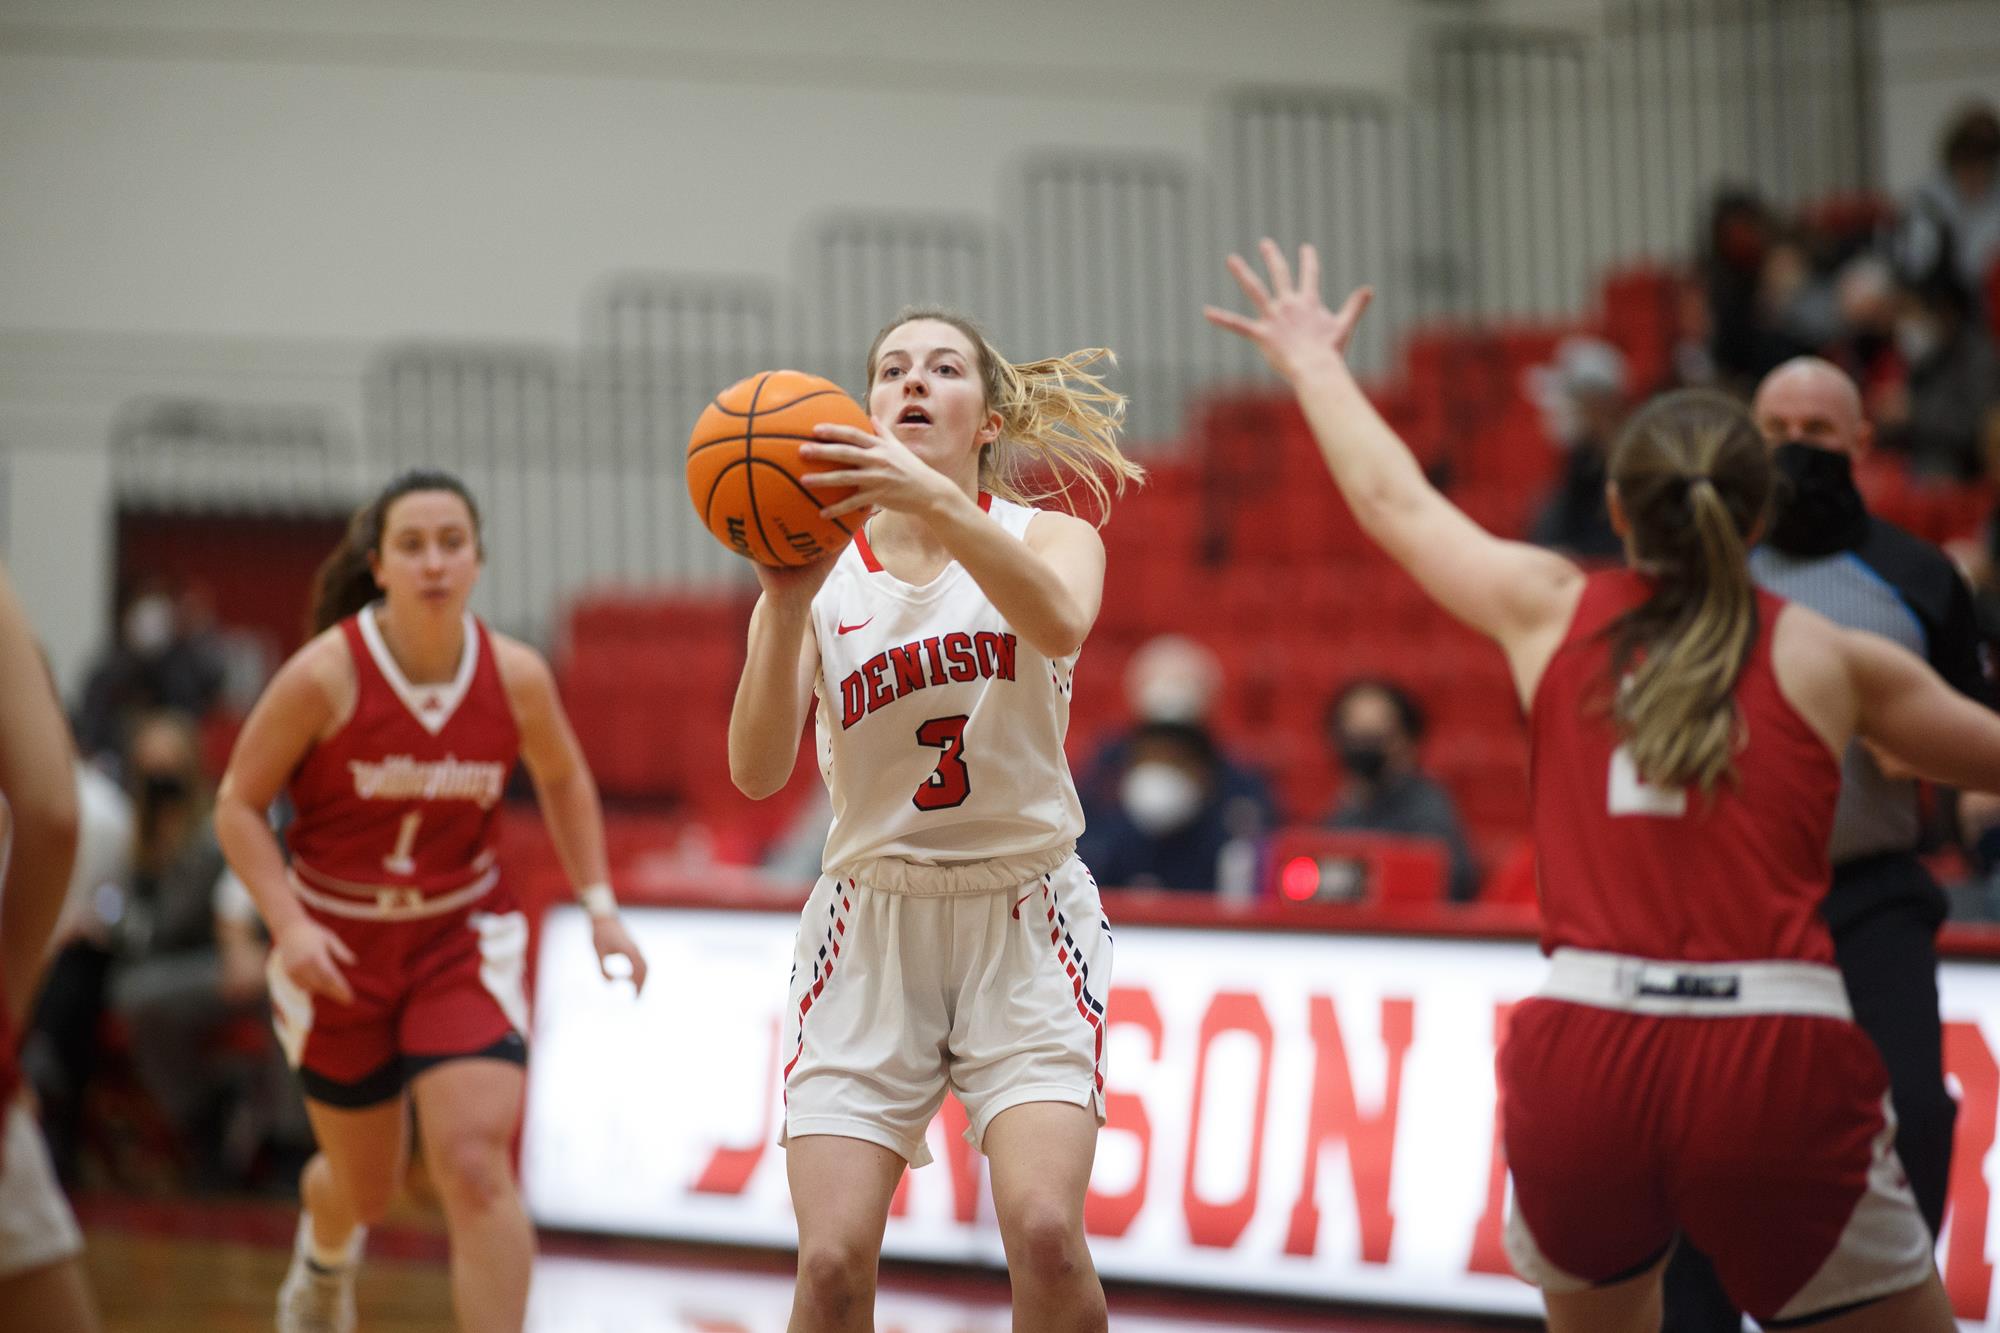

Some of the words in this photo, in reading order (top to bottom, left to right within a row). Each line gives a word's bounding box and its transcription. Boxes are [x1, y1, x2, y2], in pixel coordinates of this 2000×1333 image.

[840, 631, 1017, 731] DENISON
[912, 714, 972, 812] 3
[382, 810, 416, 876] 1
